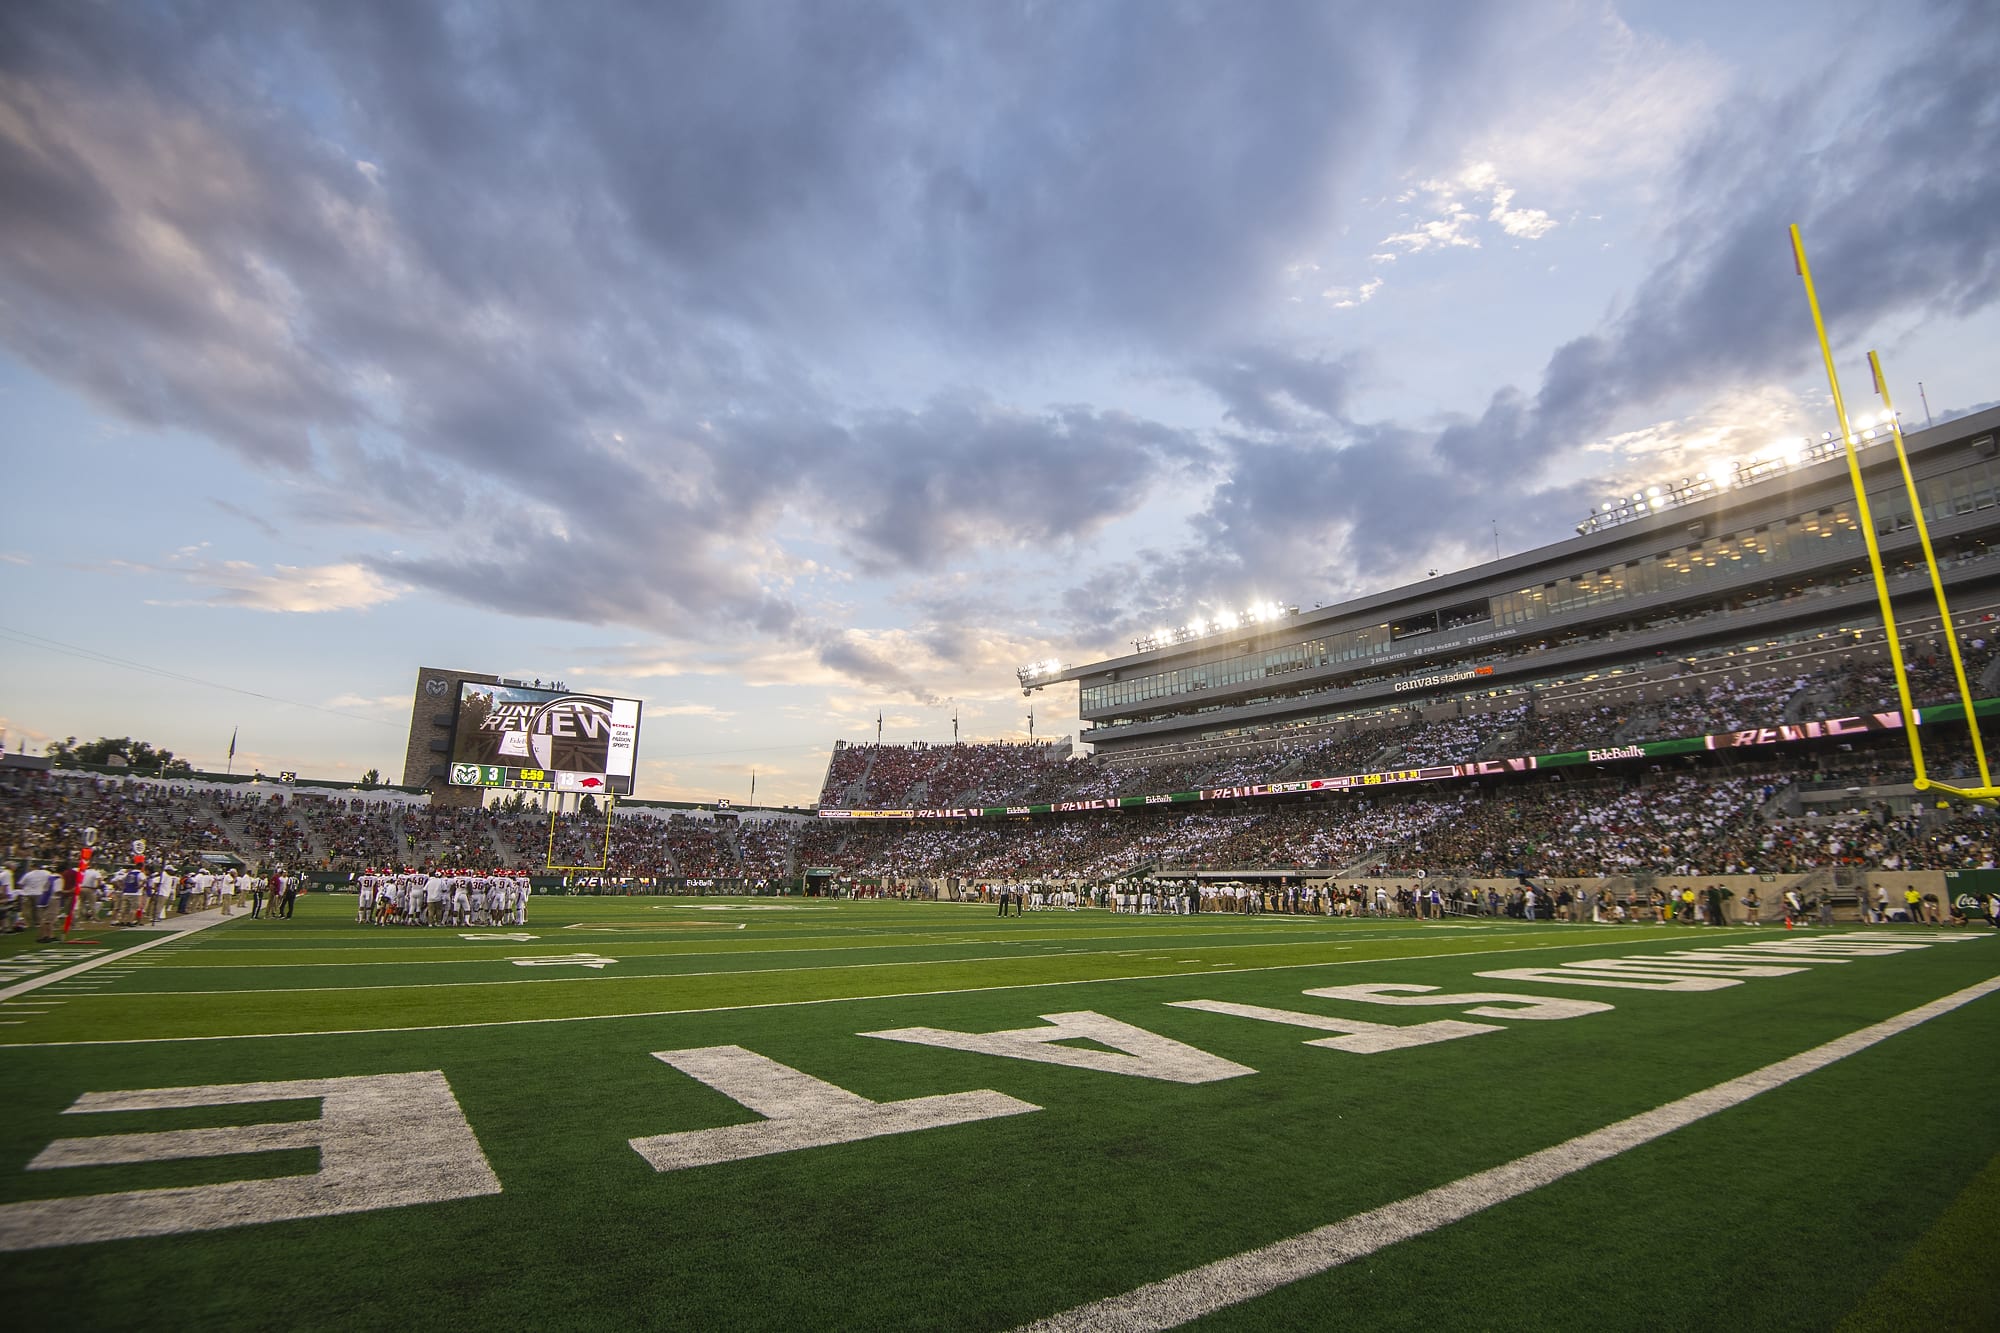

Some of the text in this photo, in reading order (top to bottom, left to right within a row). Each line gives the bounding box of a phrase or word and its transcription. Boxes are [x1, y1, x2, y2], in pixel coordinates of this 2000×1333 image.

[1395, 675, 1440, 691] canvas
[1440, 669, 1476, 684] stadium
[281, 772, 294, 782] 25
[488, 767, 499, 780] 3
[520, 769, 545, 781] 5:59
[560, 772, 575, 785] 13
[1363, 773, 1381, 785] 5:59
[363, 879, 373, 888] 91
[0, 982, 1616, 1252] STATE
